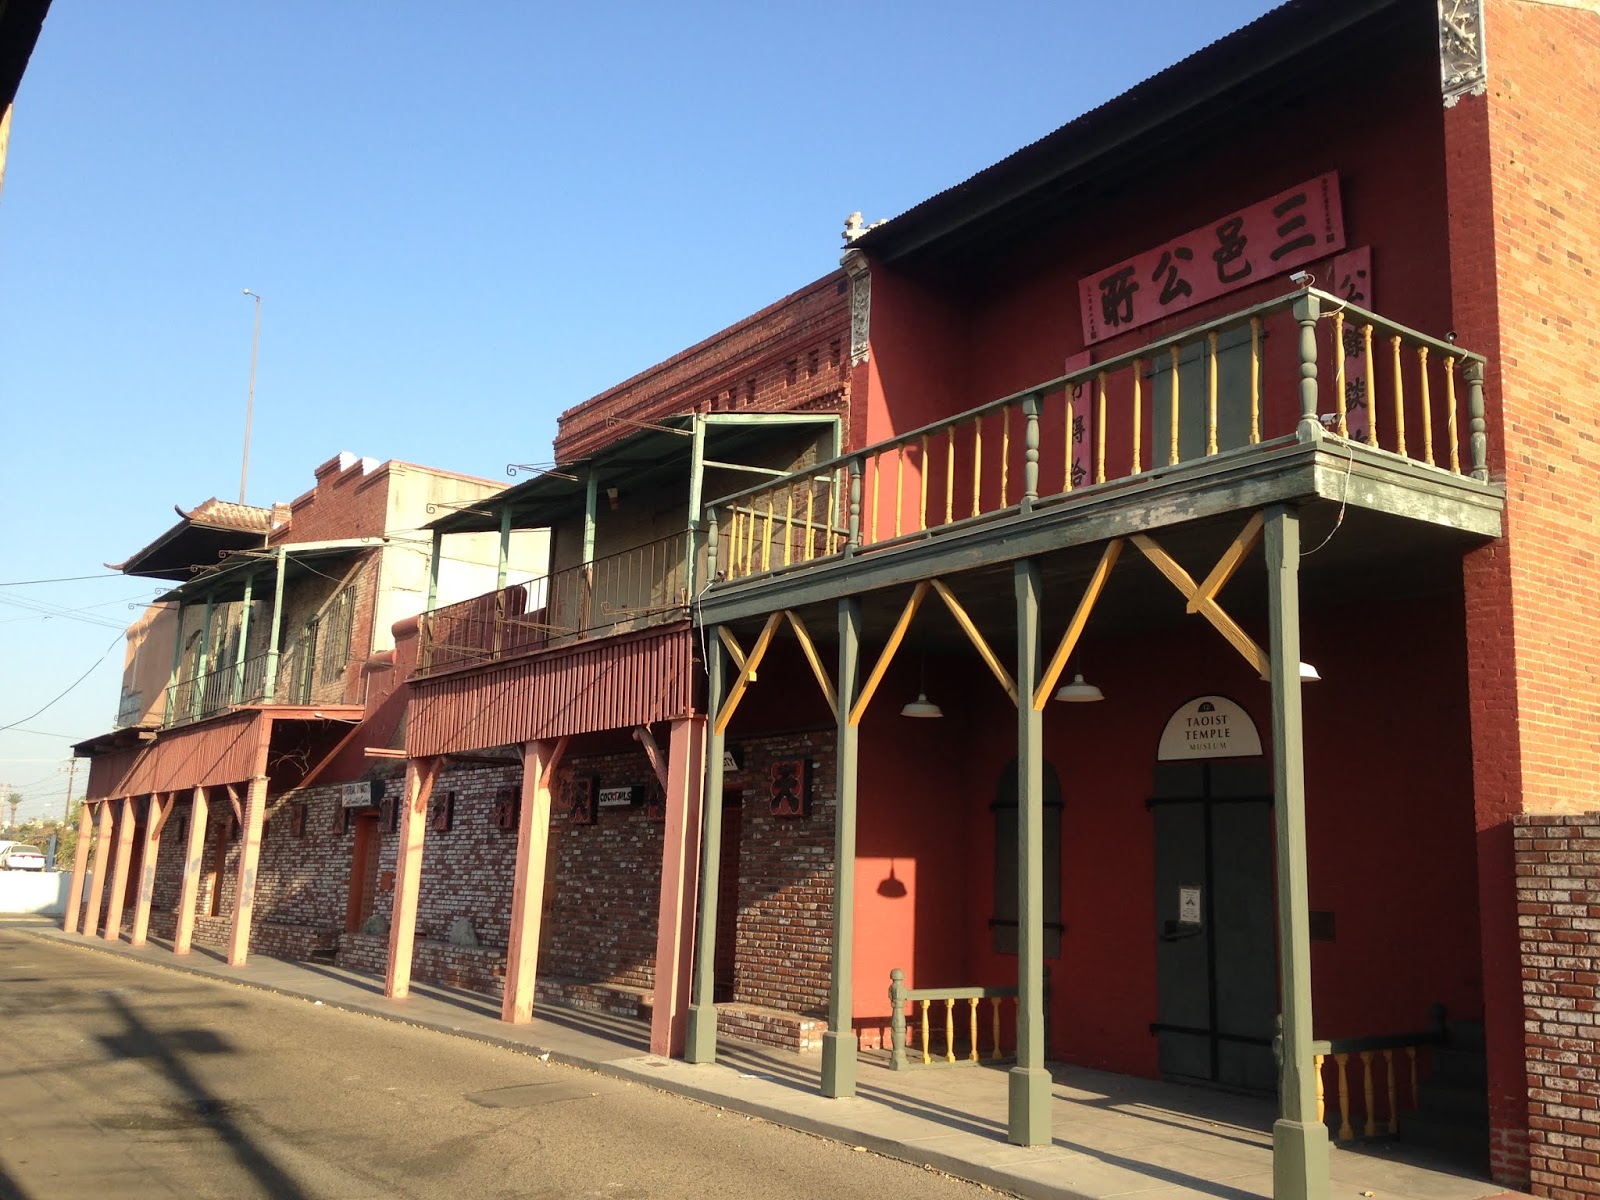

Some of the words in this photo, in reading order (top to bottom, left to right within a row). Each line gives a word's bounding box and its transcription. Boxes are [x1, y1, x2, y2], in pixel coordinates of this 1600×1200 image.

[1099, 192, 1316, 328] 三邑公所
[1186, 714, 1228, 728] TAOIST
[1184, 727, 1231, 741] TEMPLE
[1189, 742, 1227, 751] MUSEUM
[599, 790, 632, 802] COCKTAILS
